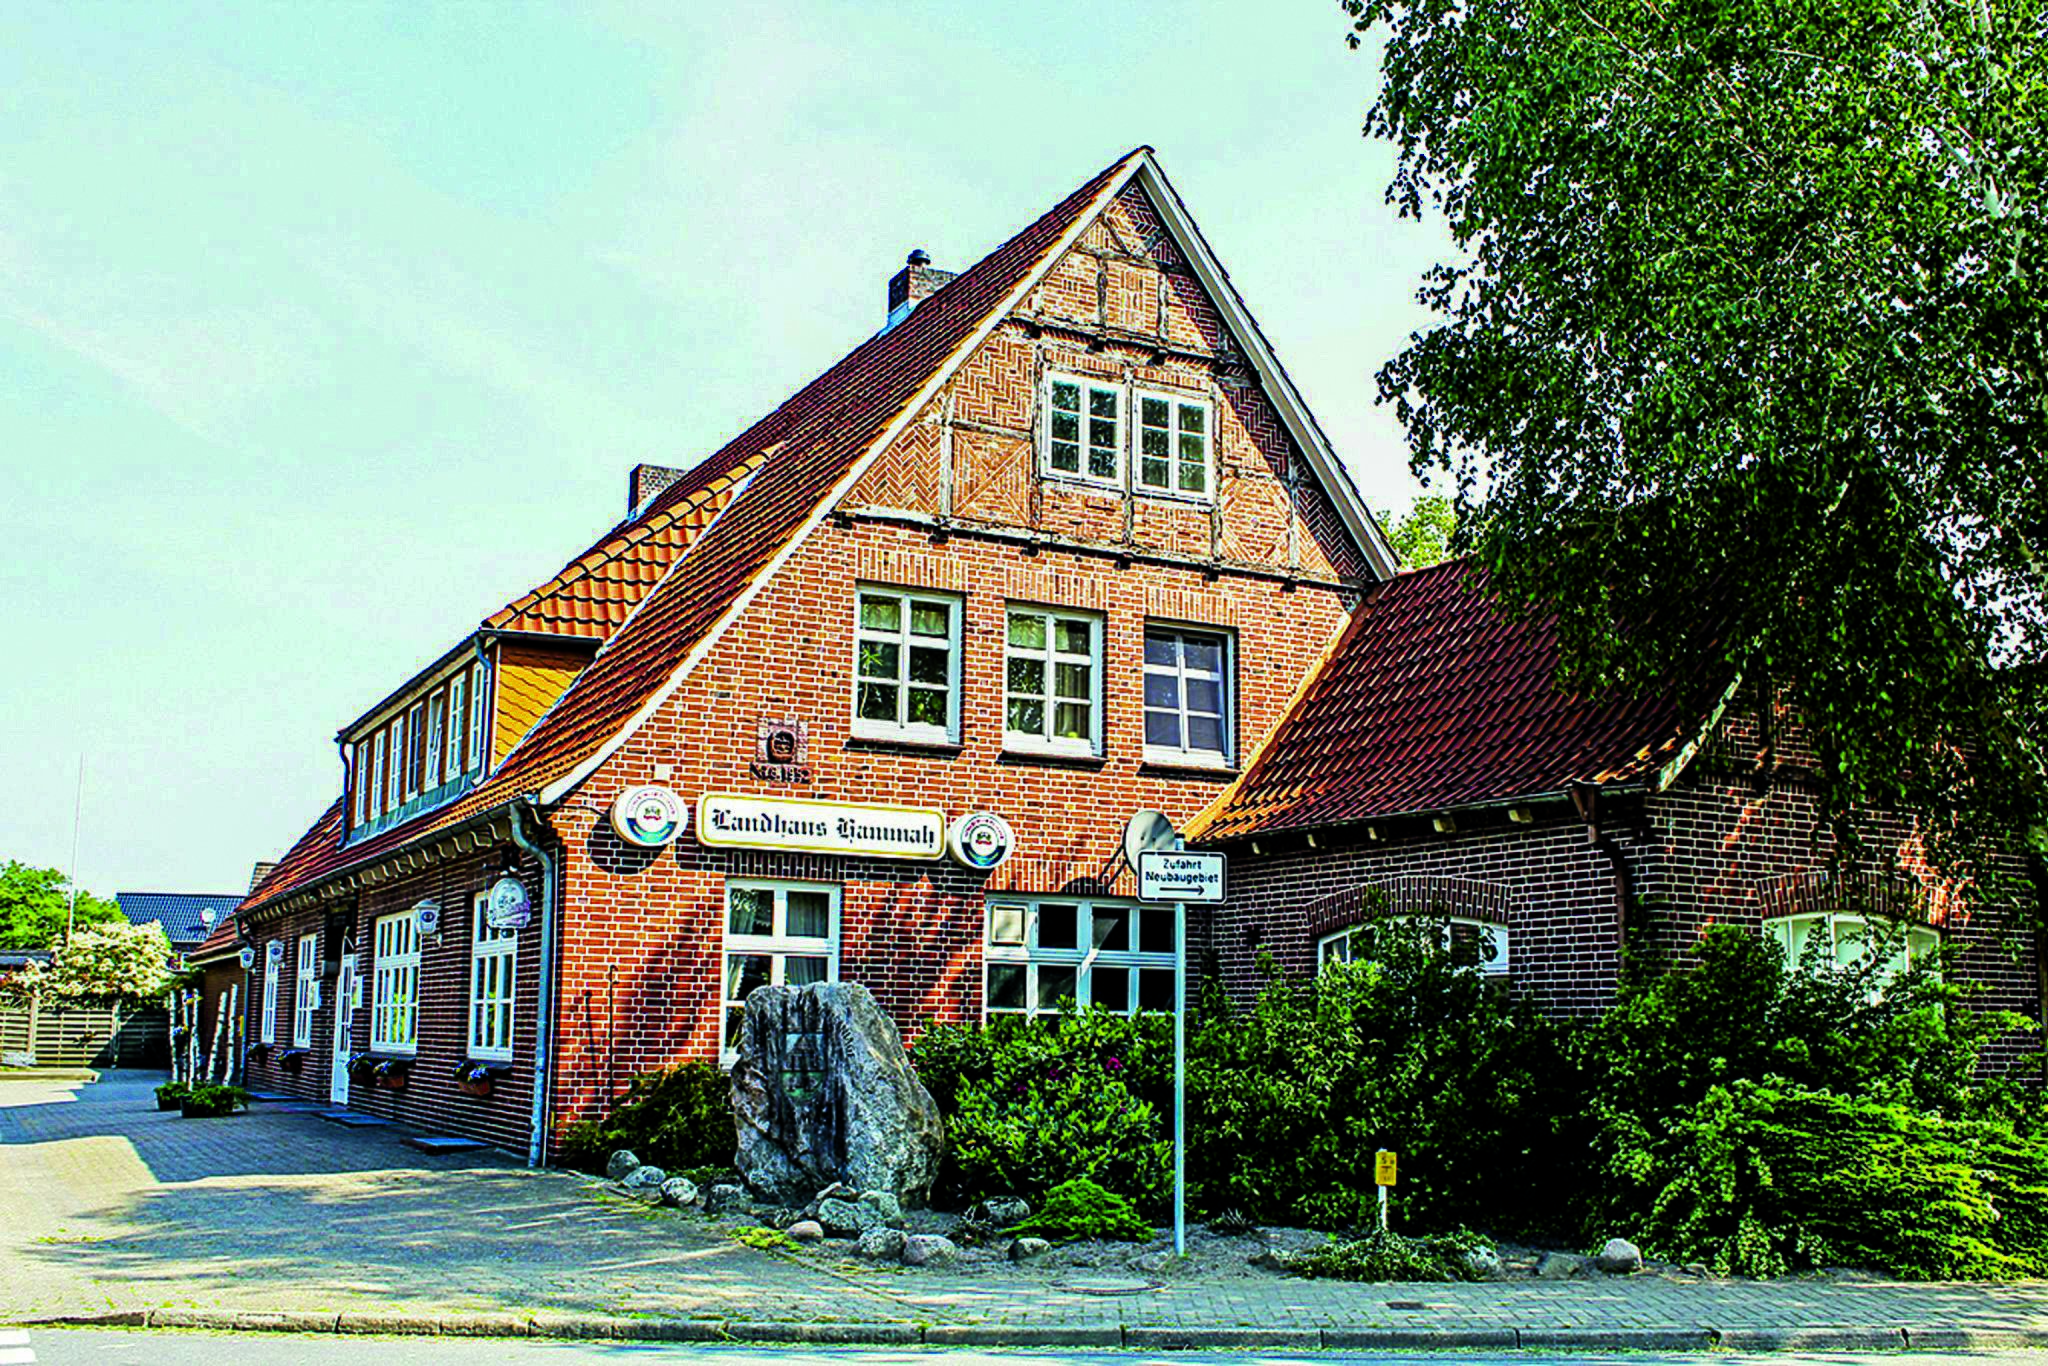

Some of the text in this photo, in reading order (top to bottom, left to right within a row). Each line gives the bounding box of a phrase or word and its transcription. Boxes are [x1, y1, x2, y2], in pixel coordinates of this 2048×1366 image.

[711, 808, 828, 837] Landhaus
[836, 817, 935, 849] Hammah
[1163, 858, 1202, 870] Zufahrt
[1145, 871, 1219, 885] Neubaugebiet
